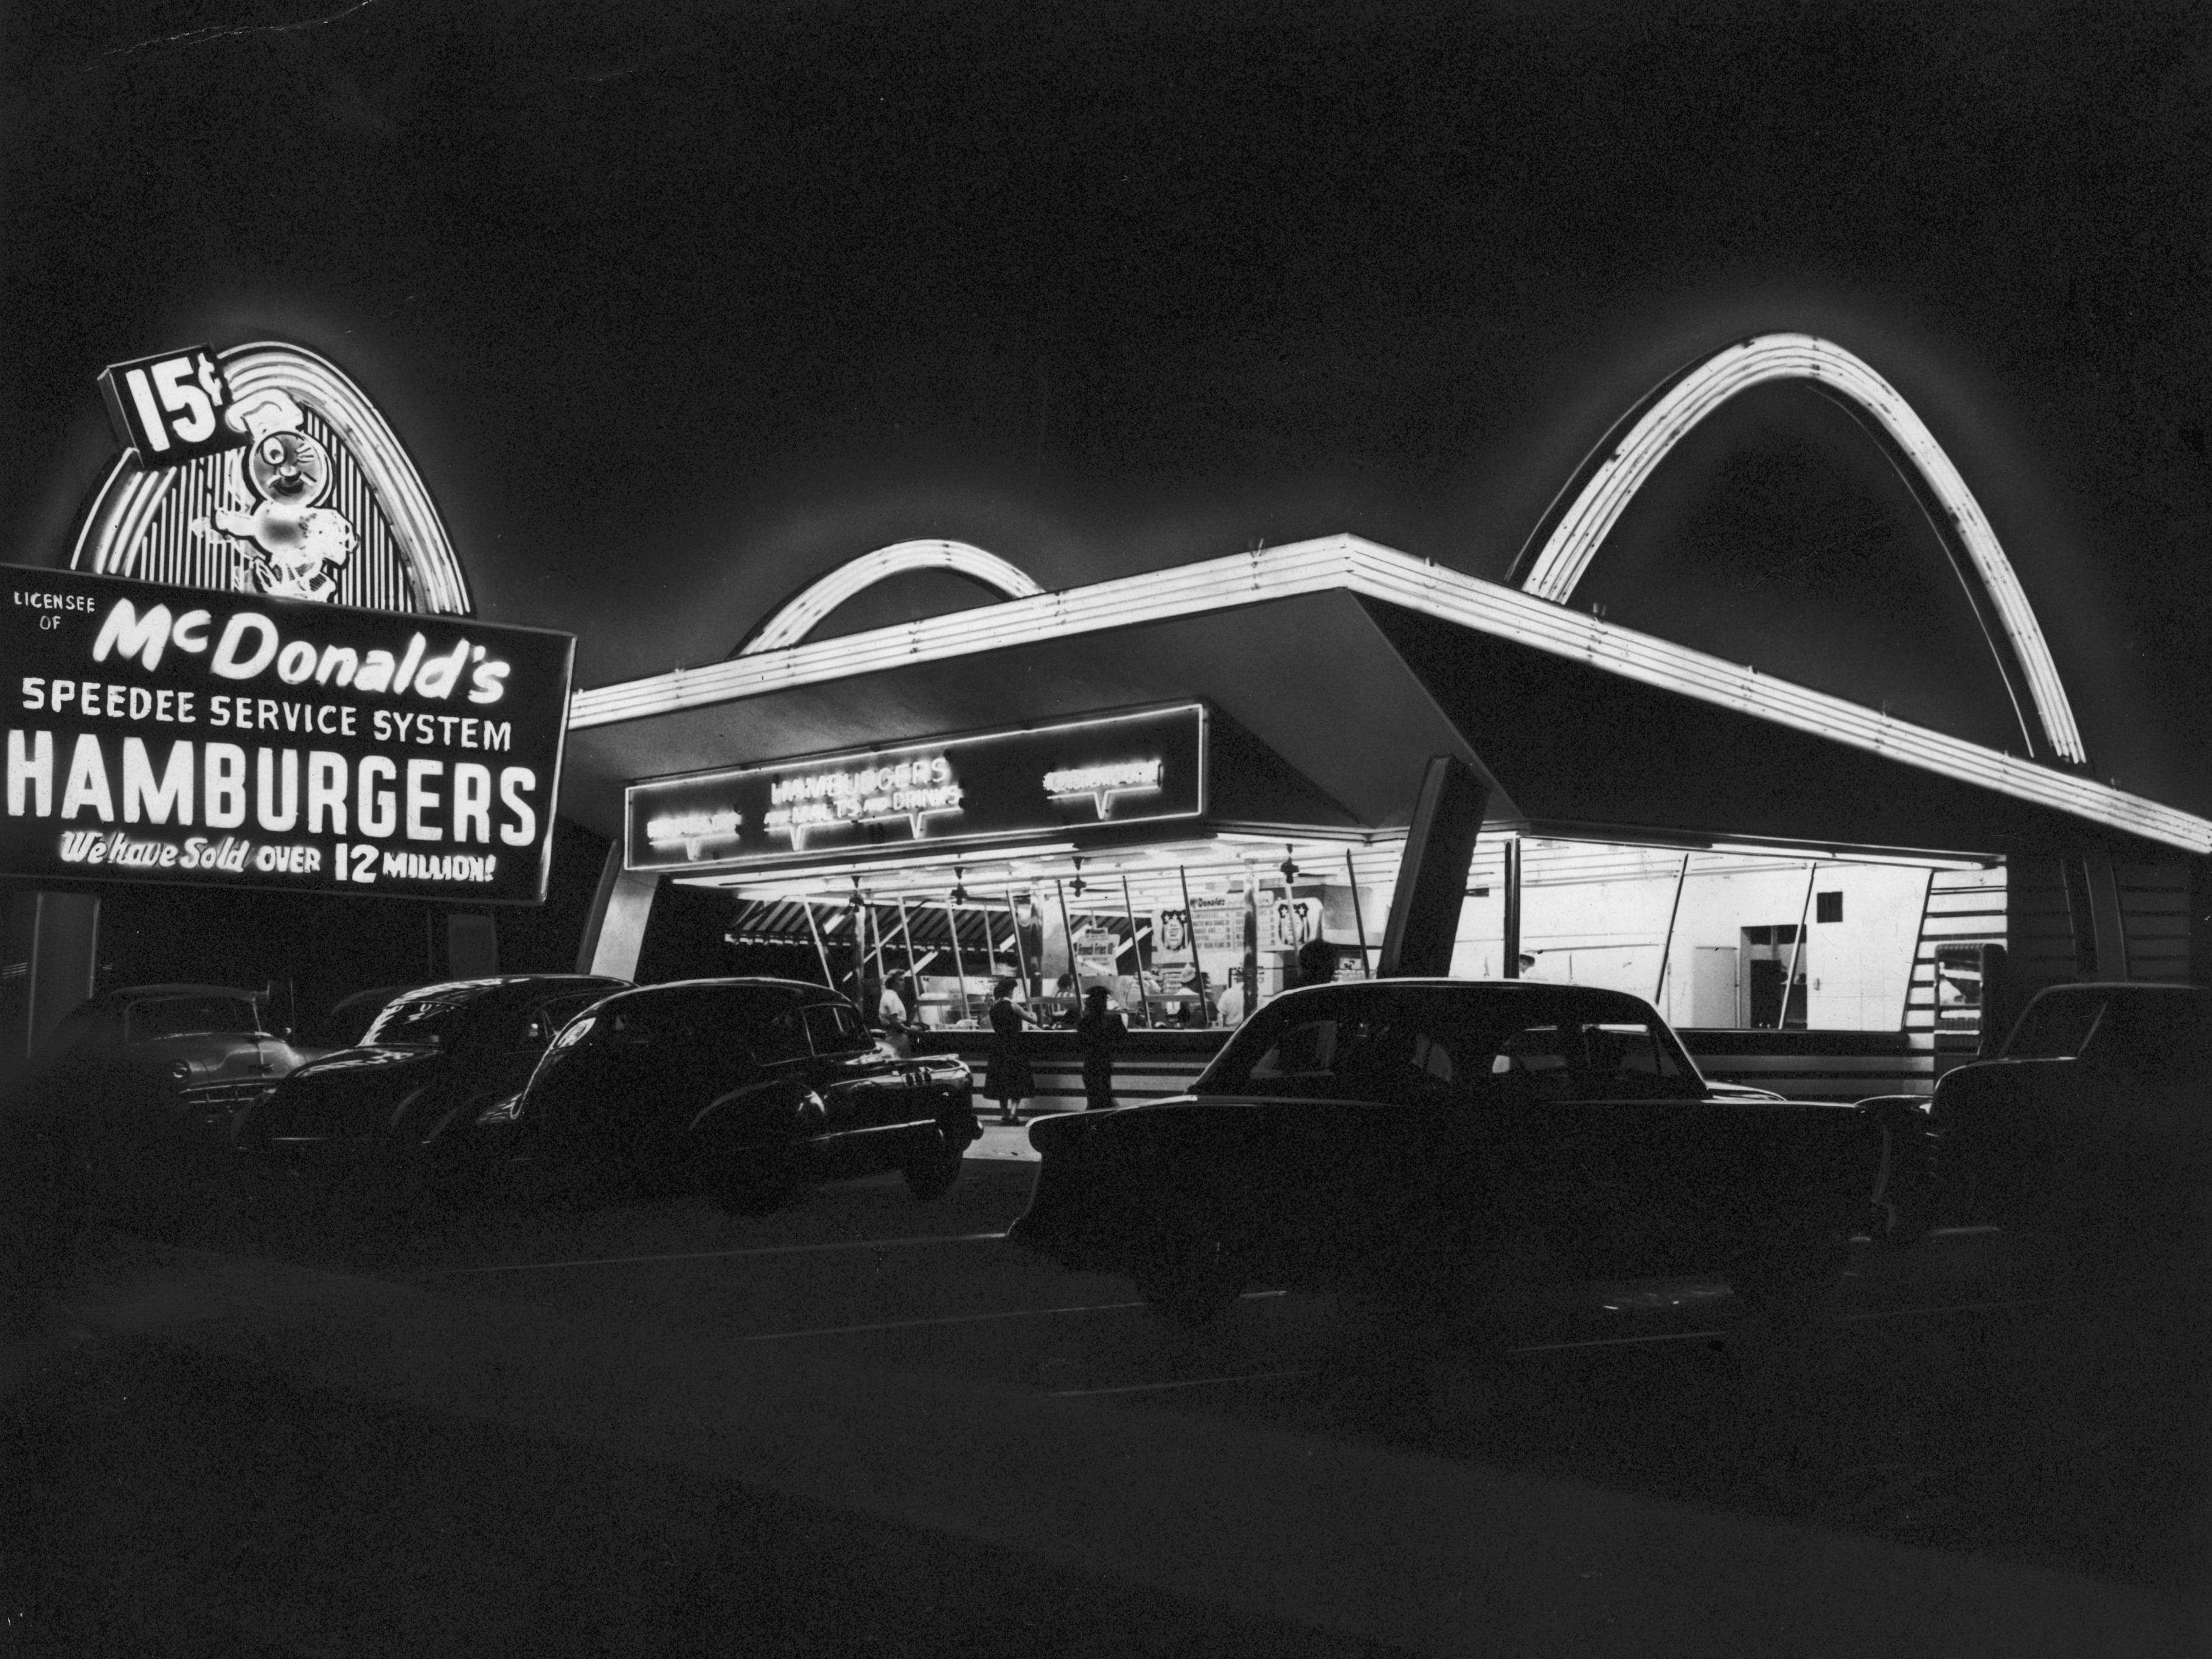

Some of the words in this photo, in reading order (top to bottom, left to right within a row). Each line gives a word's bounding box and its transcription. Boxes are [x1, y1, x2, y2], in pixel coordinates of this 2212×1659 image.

[125, 352, 223, 452] 15¢
[13, 591, 96, 614] LICENSEE
[39, 614, 61, 630] OF
[92, 597, 511, 704] McDonald's
[22, 677, 197, 723] SPEEDEE
[210, 695, 356, 736] SERVICE
[373, 709, 512, 752] SYSTEM
[7, 729, 537, 846] HAMBURGERS
[771, 756, 950, 805] HAMBURGERS
[892, 785, 962, 810] DRINKS
[60, 830, 108, 864] We
[106, 832, 180, 868] have
[179, 836, 251, 873] Sold
[254, 845, 321, 874] OVER
[335, 843, 380, 883] 12
[382, 852, 496, 882] MILLION!
